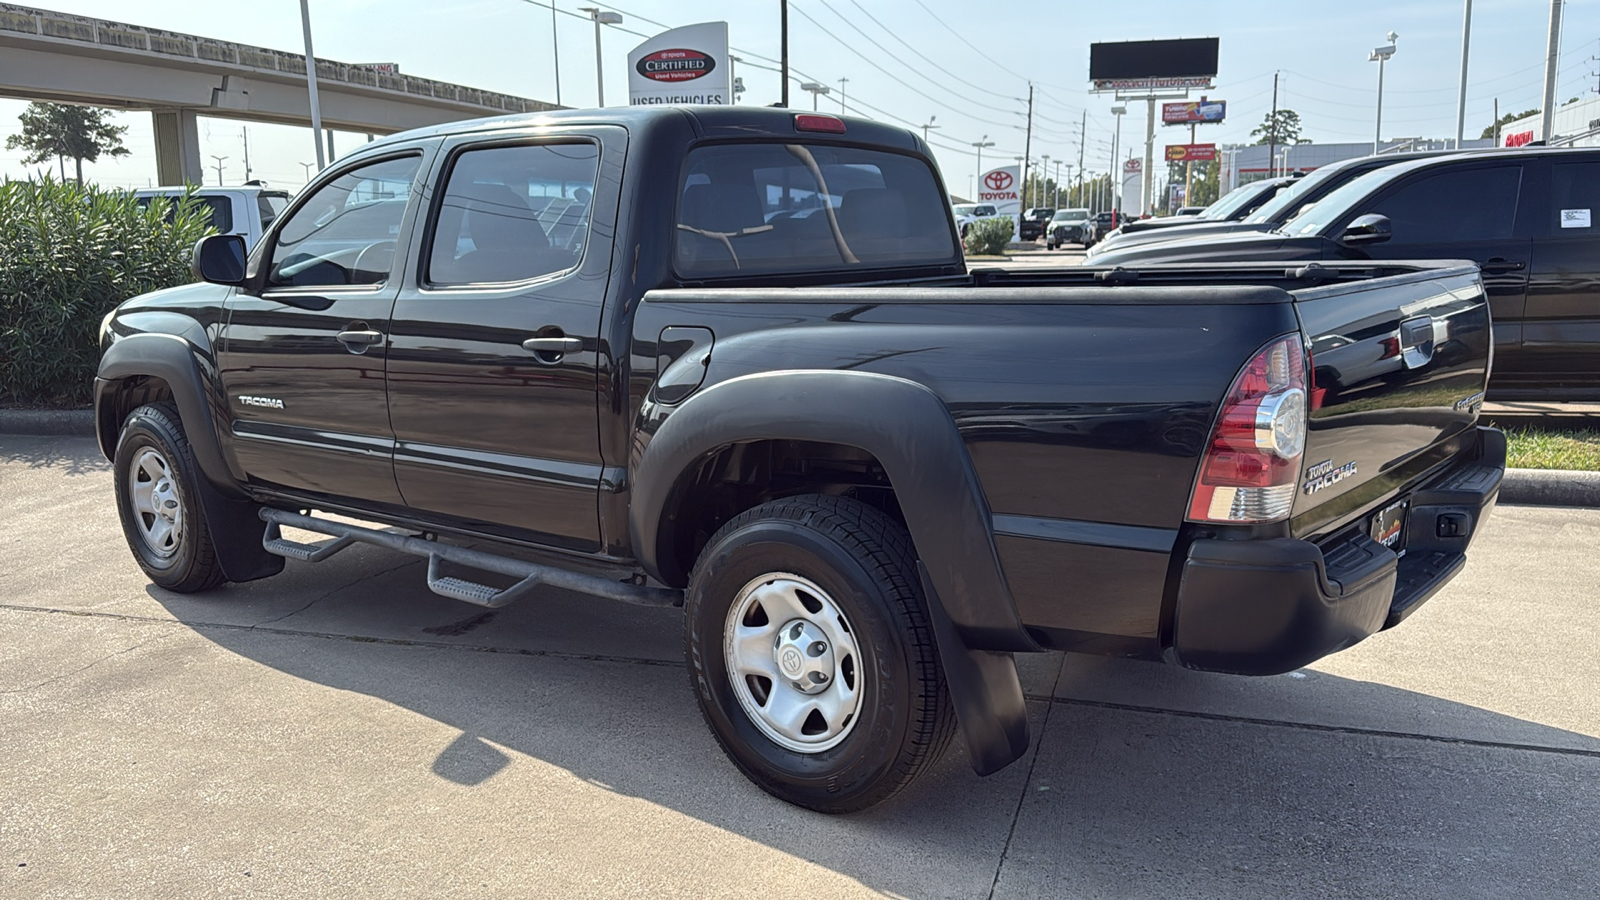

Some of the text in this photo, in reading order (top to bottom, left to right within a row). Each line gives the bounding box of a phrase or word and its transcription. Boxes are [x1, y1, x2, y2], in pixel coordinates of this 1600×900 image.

[645, 60, 705, 71] CERTIFIED
[980, 191, 1018, 200] TOYOTA
[238, 395, 285, 410] TACOMA
[1308, 459, 1333, 479] TOYOTA
[1304, 461, 1358, 495] TACOMA
